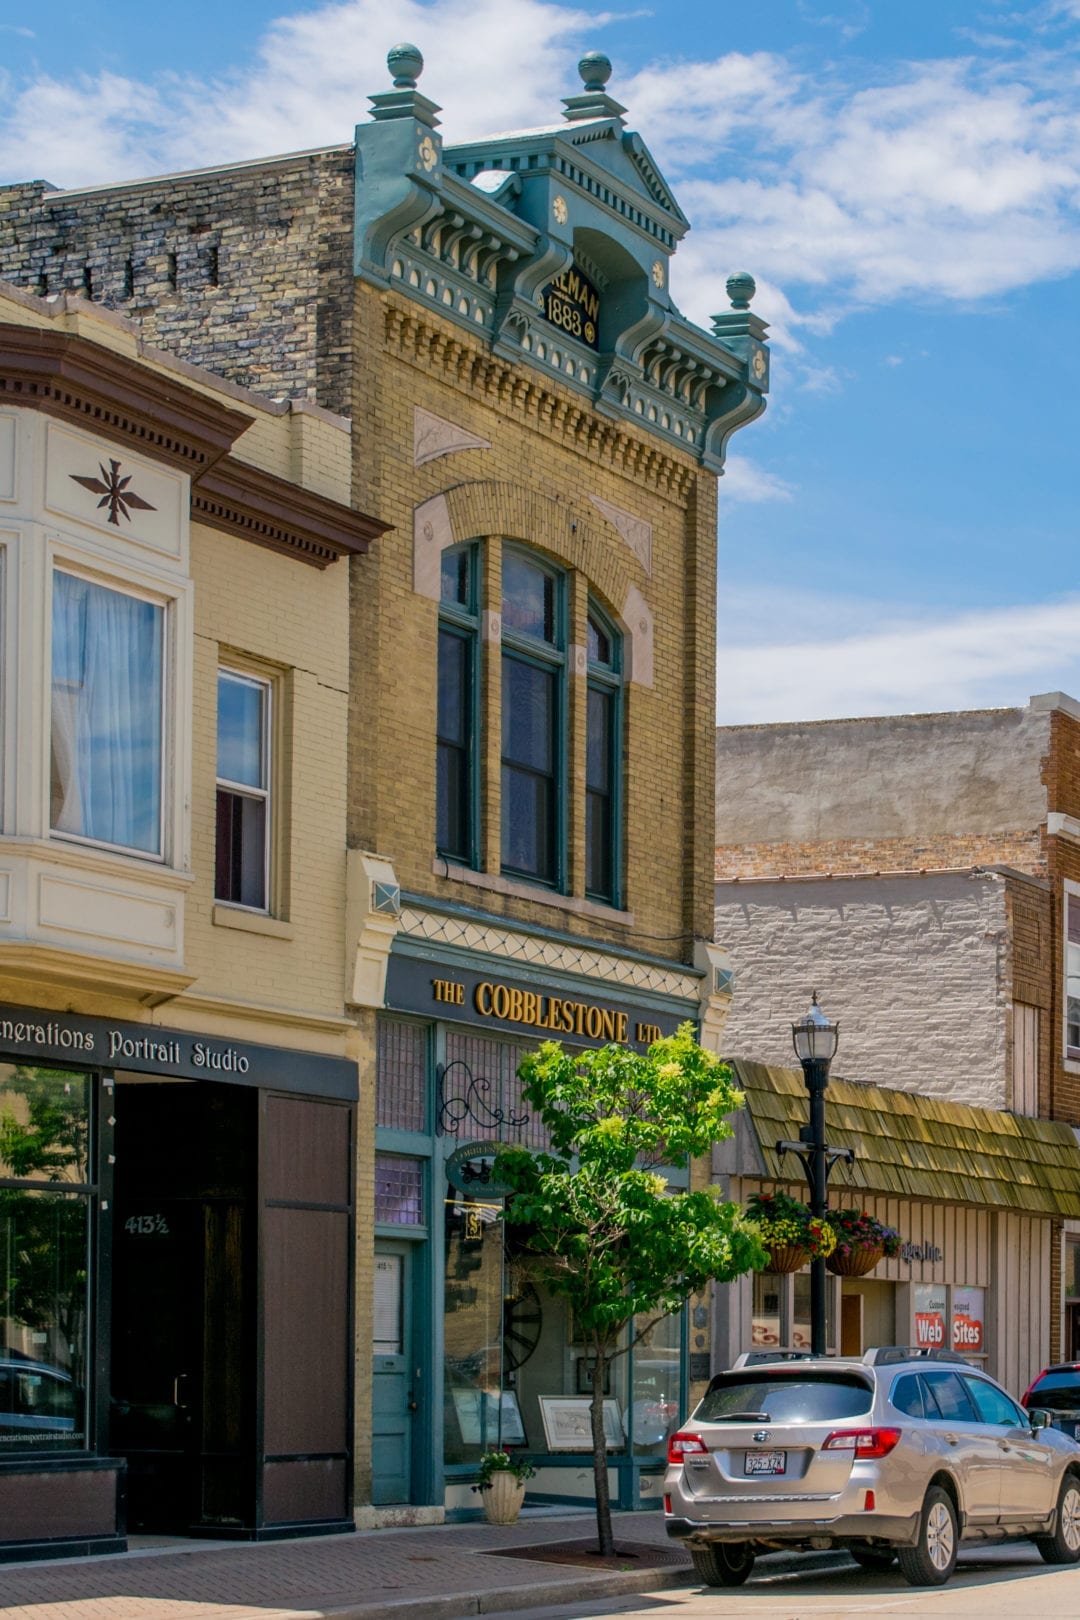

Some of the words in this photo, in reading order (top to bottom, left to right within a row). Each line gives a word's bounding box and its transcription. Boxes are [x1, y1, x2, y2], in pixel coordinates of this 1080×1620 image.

[547, 294, 582, 337] 1883
[432, 978, 466, 1006] THE
[475, 981, 630, 1044] COBBLESTONE
[0, 1020, 96, 1051] nerations
[108, 1030, 182, 1064] Portrait
[192, 1042, 250, 1074] Studio
[953, 1302, 970, 1312] esigned
[918, 1319, 943, 1343] Web
[952, 1320, 979, 1344] Sites
